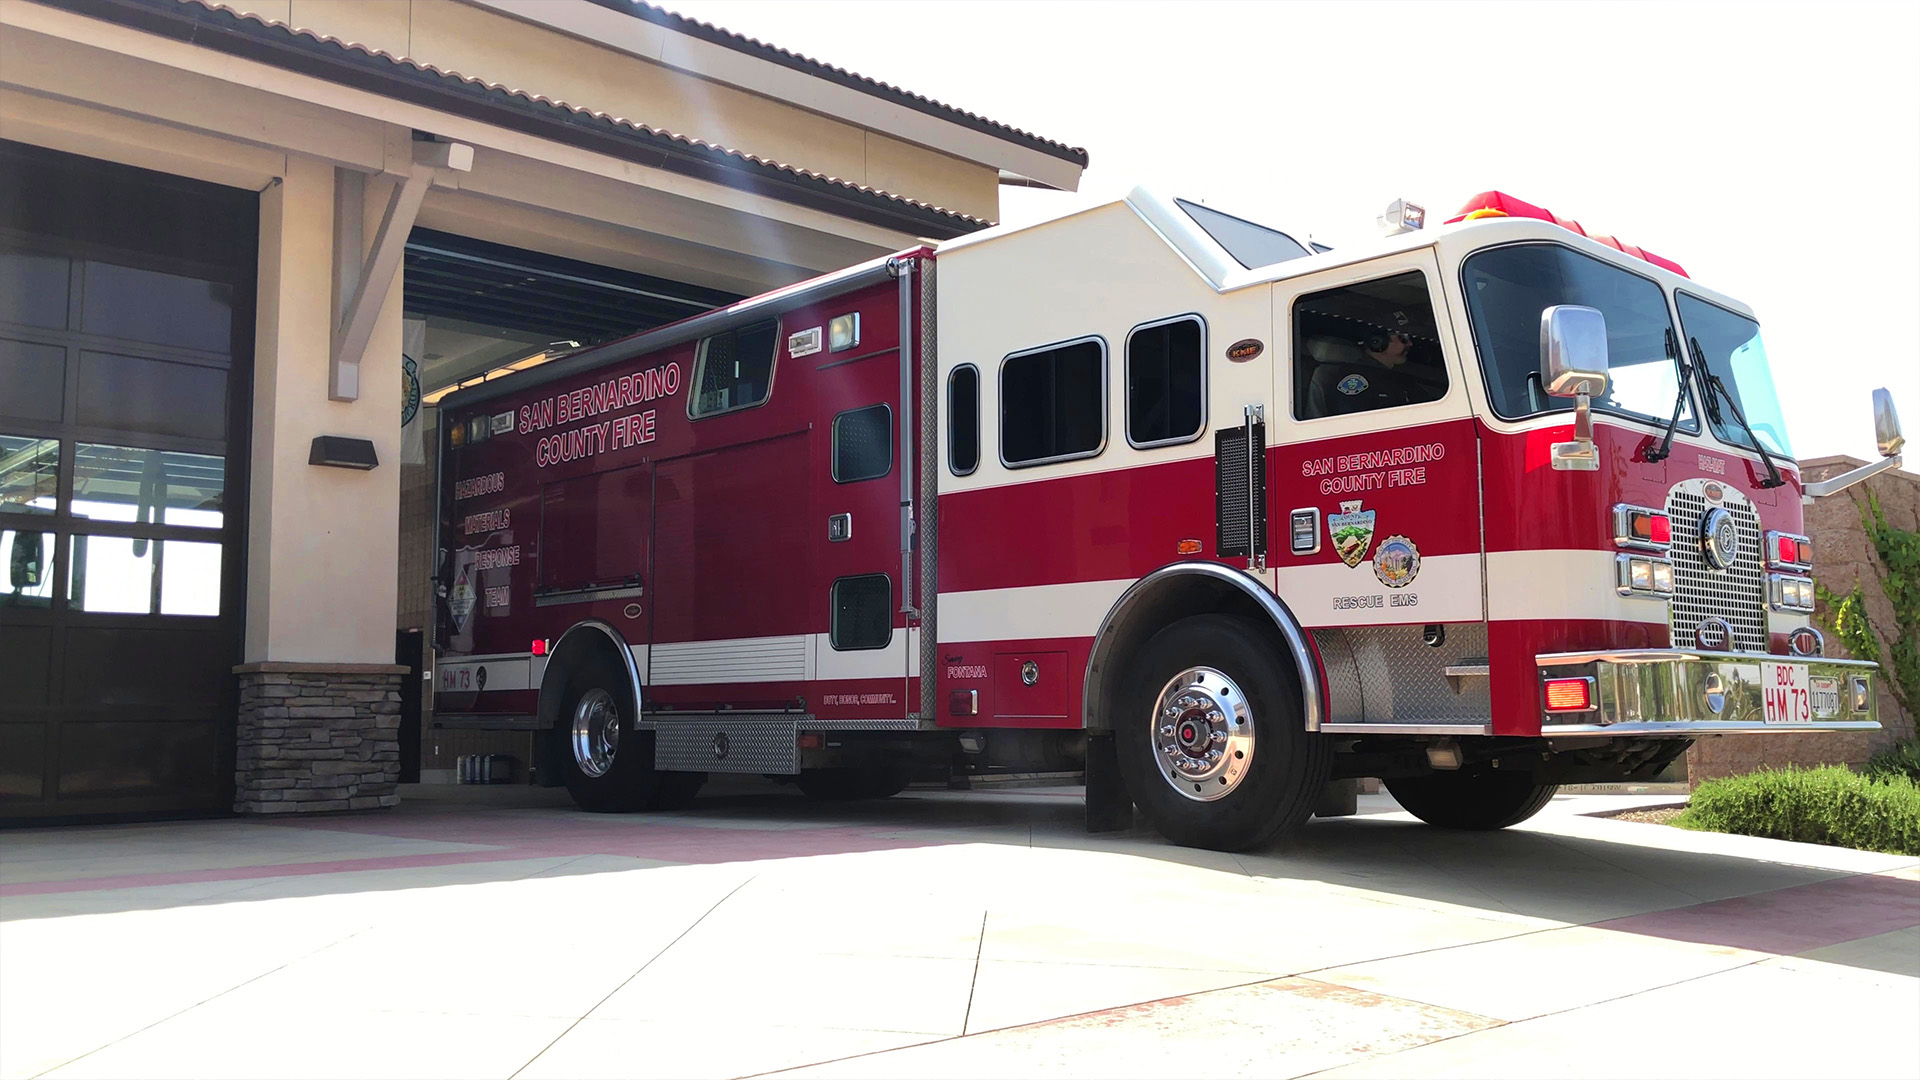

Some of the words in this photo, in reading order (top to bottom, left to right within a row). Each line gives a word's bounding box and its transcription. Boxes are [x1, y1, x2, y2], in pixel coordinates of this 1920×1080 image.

[518, 395, 553, 435] SAN
[557, 362, 682, 424] BERNARDINO
[536, 421, 610, 467] COUNTY
[612, 410, 656, 449] FIRE
[1302, 458, 1334, 477] SAN
[1337, 442, 1445, 472] BERNARDINO
[455, 472, 505, 500] HAZARDOUS
[1320, 472, 1385, 495] COUNTY
[1388, 467, 1426, 488] FIRE
[465, 509, 510, 535] MATERIALS
[475, 545, 520, 571] RESPONSE
[485, 586, 510, 608] TEAM
[1333, 595, 1384, 609] RESCUE
[1390, 593, 1418, 607] EMS
[443, 670, 456, 688] HM
[460, 670, 471, 688] 73
[947, 665, 988, 679] FONTANA
[1776, 665, 1795, 687] BDC
[1765, 688, 1789, 721] HM
[1791, 688, 1809, 721] 73
